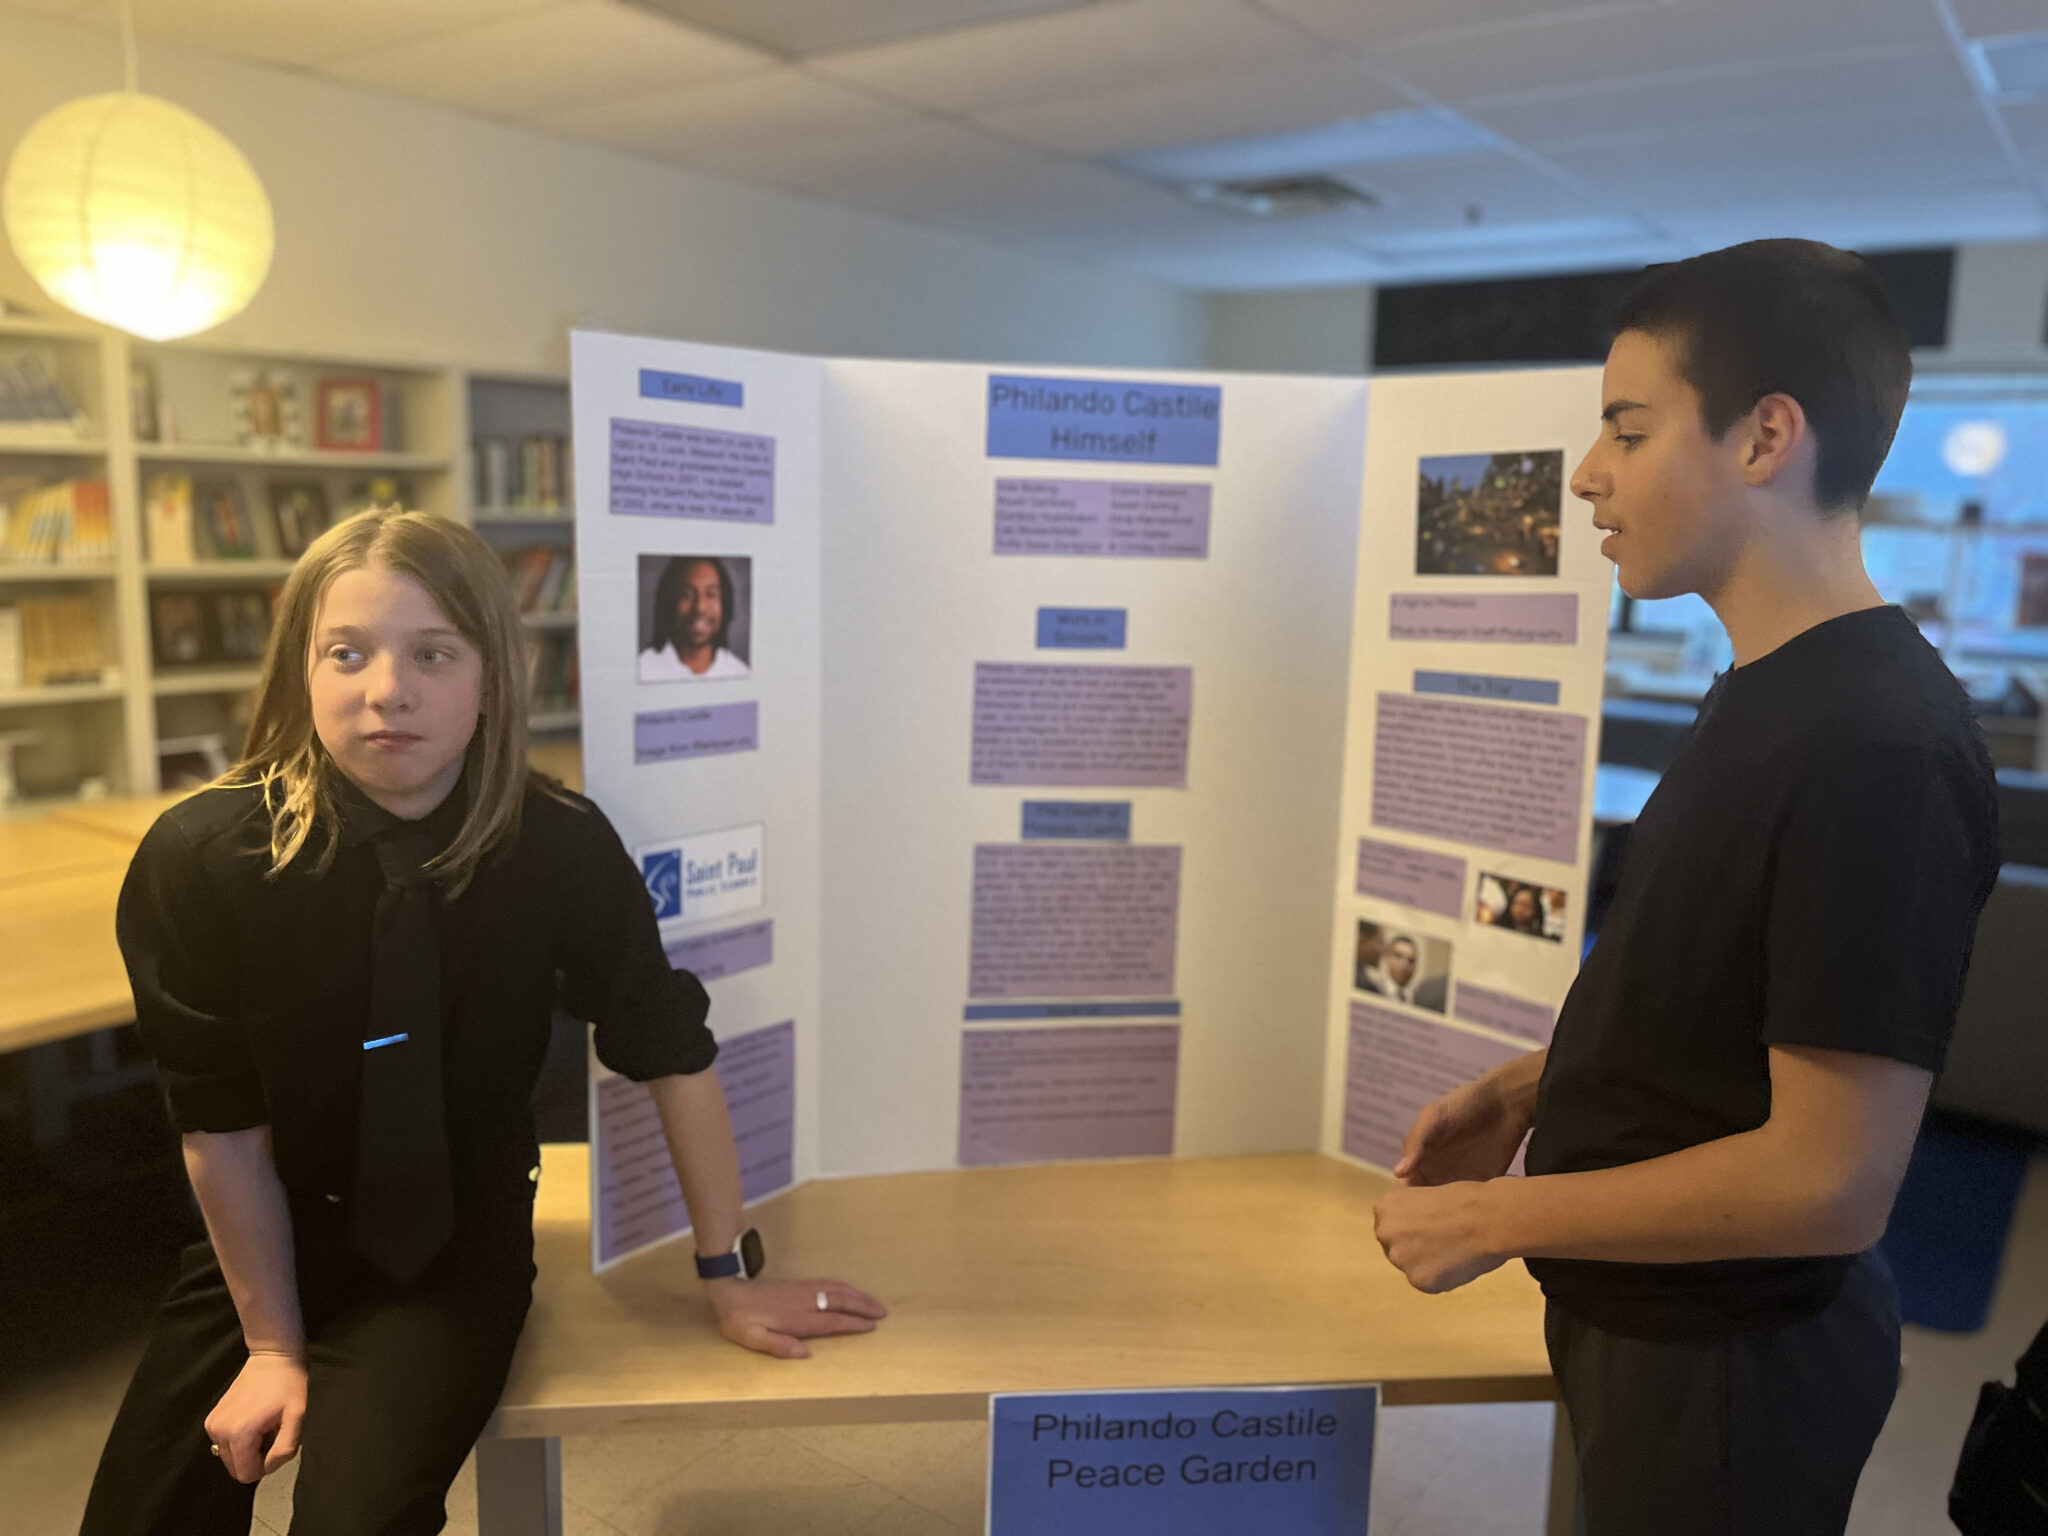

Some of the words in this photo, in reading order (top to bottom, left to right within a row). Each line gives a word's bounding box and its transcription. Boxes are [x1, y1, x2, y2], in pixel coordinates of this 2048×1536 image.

[992, 383, 1117, 415] Philando
[1123, 389, 1219, 420] Castile
[1051, 426, 1157, 454] Himself
[686, 860, 722, 884] Saint
[728, 848, 758, 876] Paul
[1032, 1411, 1197, 1442] Philando
[1211, 1407, 1337, 1439] Castile
[1048, 1457, 1166, 1488] Peace
[1180, 1453, 1317, 1485] Garden
